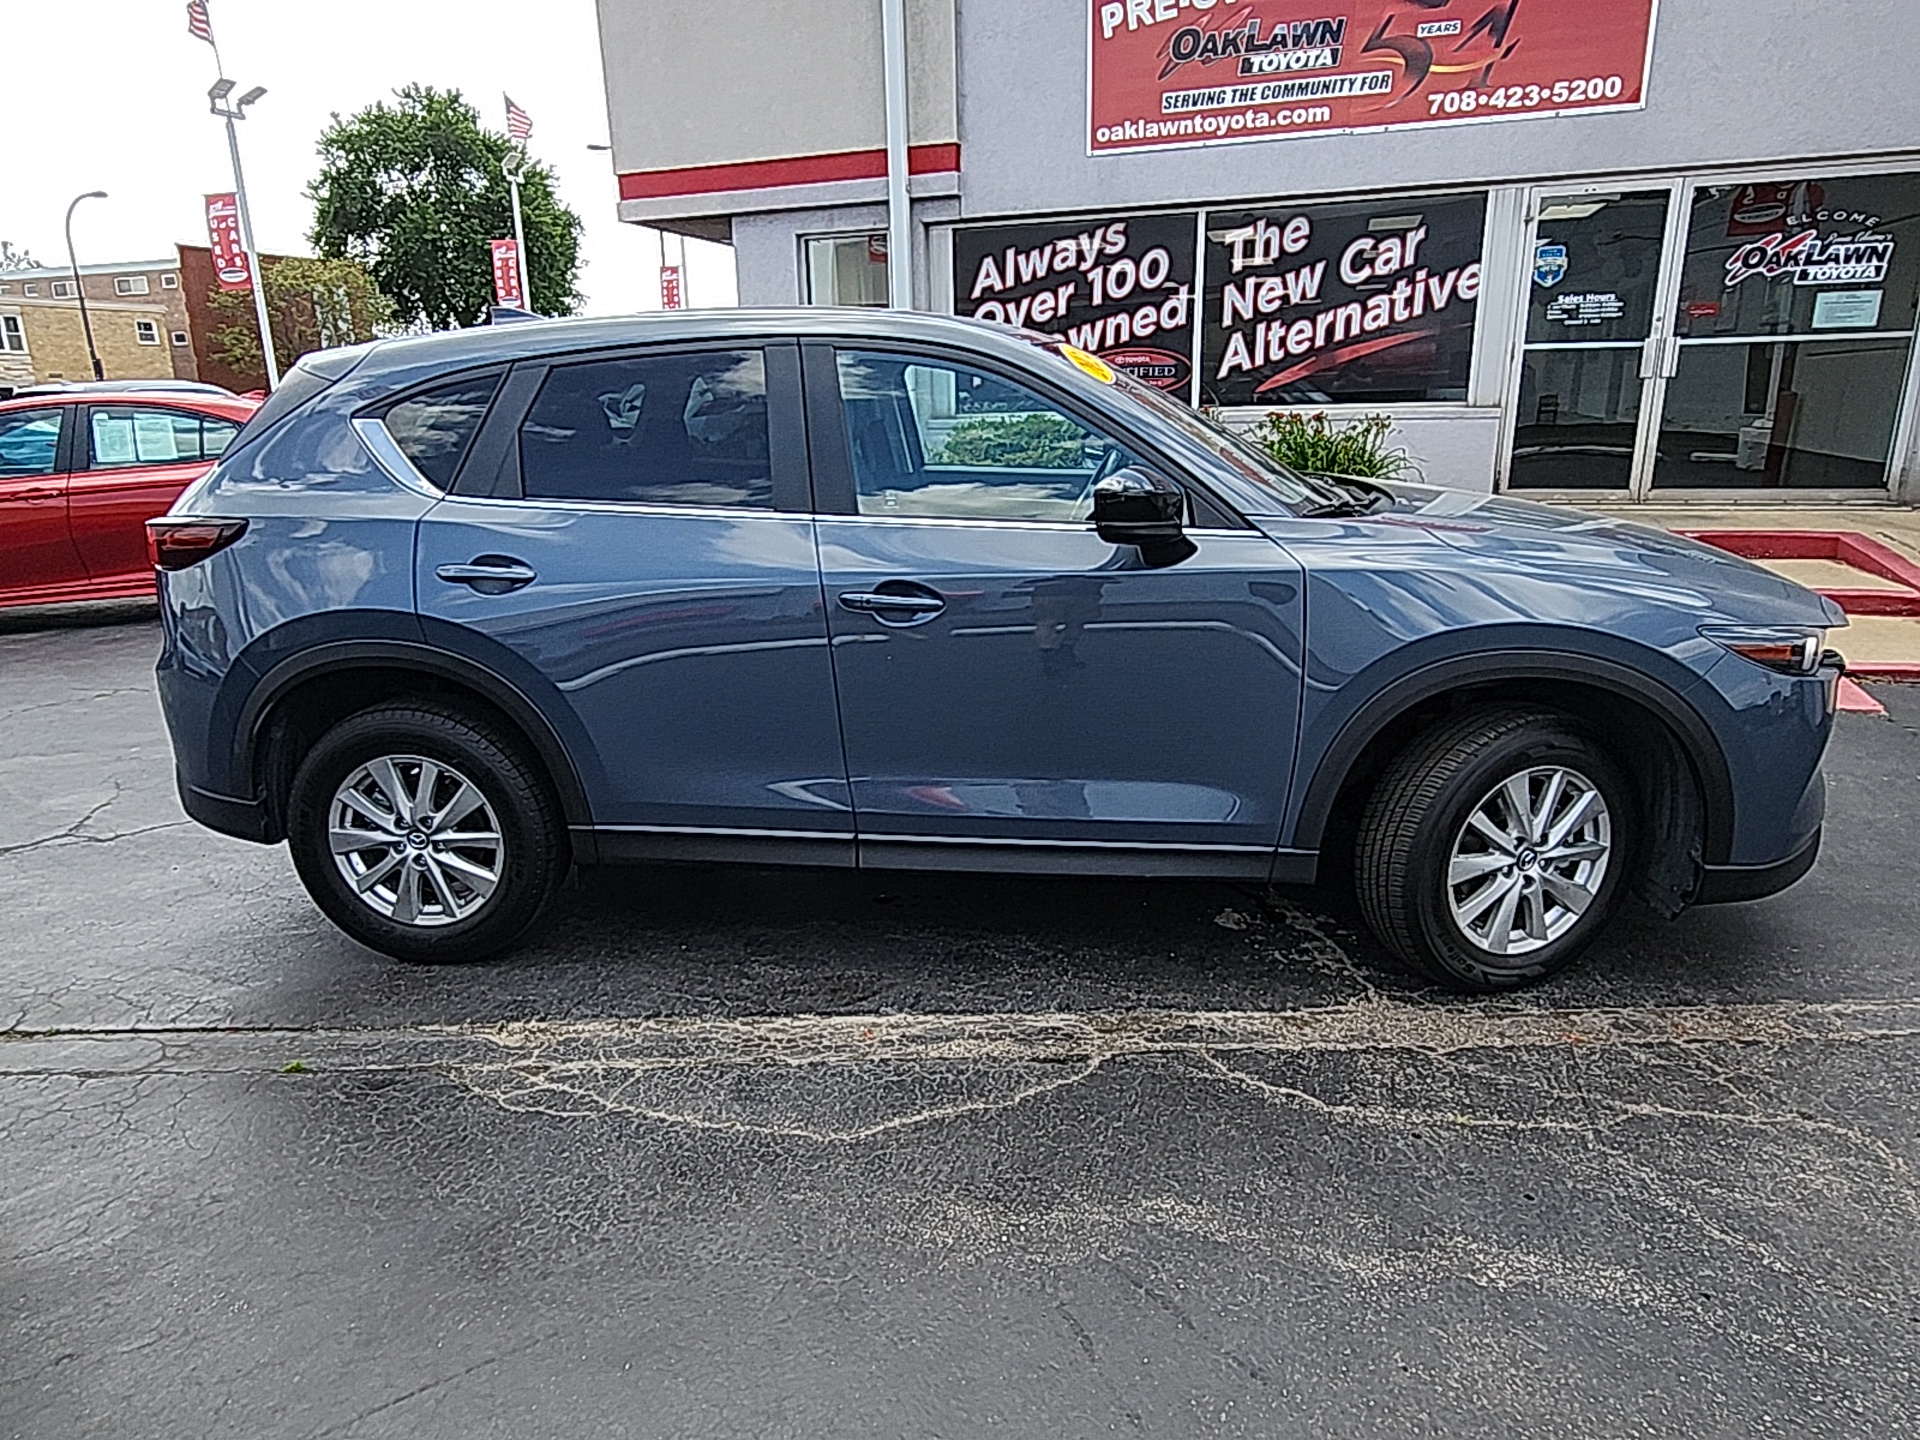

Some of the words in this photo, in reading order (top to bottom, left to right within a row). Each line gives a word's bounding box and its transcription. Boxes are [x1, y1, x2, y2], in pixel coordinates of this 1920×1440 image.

[1419, 22, 1460, 35] YEARS
[1249, 48, 1335, 74] TOYOTA
[1163, 90, 1227, 111] SERVING
[1230, 86, 1258, 104] THE
[1260, 77, 1358, 101] COMMUNITY
[1359, 73, 1391, 92] FOR
[1096, 105, 1331, 143] oaklawntoyota.com
[970, 221, 1128, 300] Always
[1224, 216, 1310, 274] The
[1086, 247, 1171, 307] 100
[1221, 259, 1327, 329] New
[1339, 225, 1427, 285] Car
[1805, 266, 1876, 281] TOYOTA
[1215, 263, 1481, 380] Alternative
